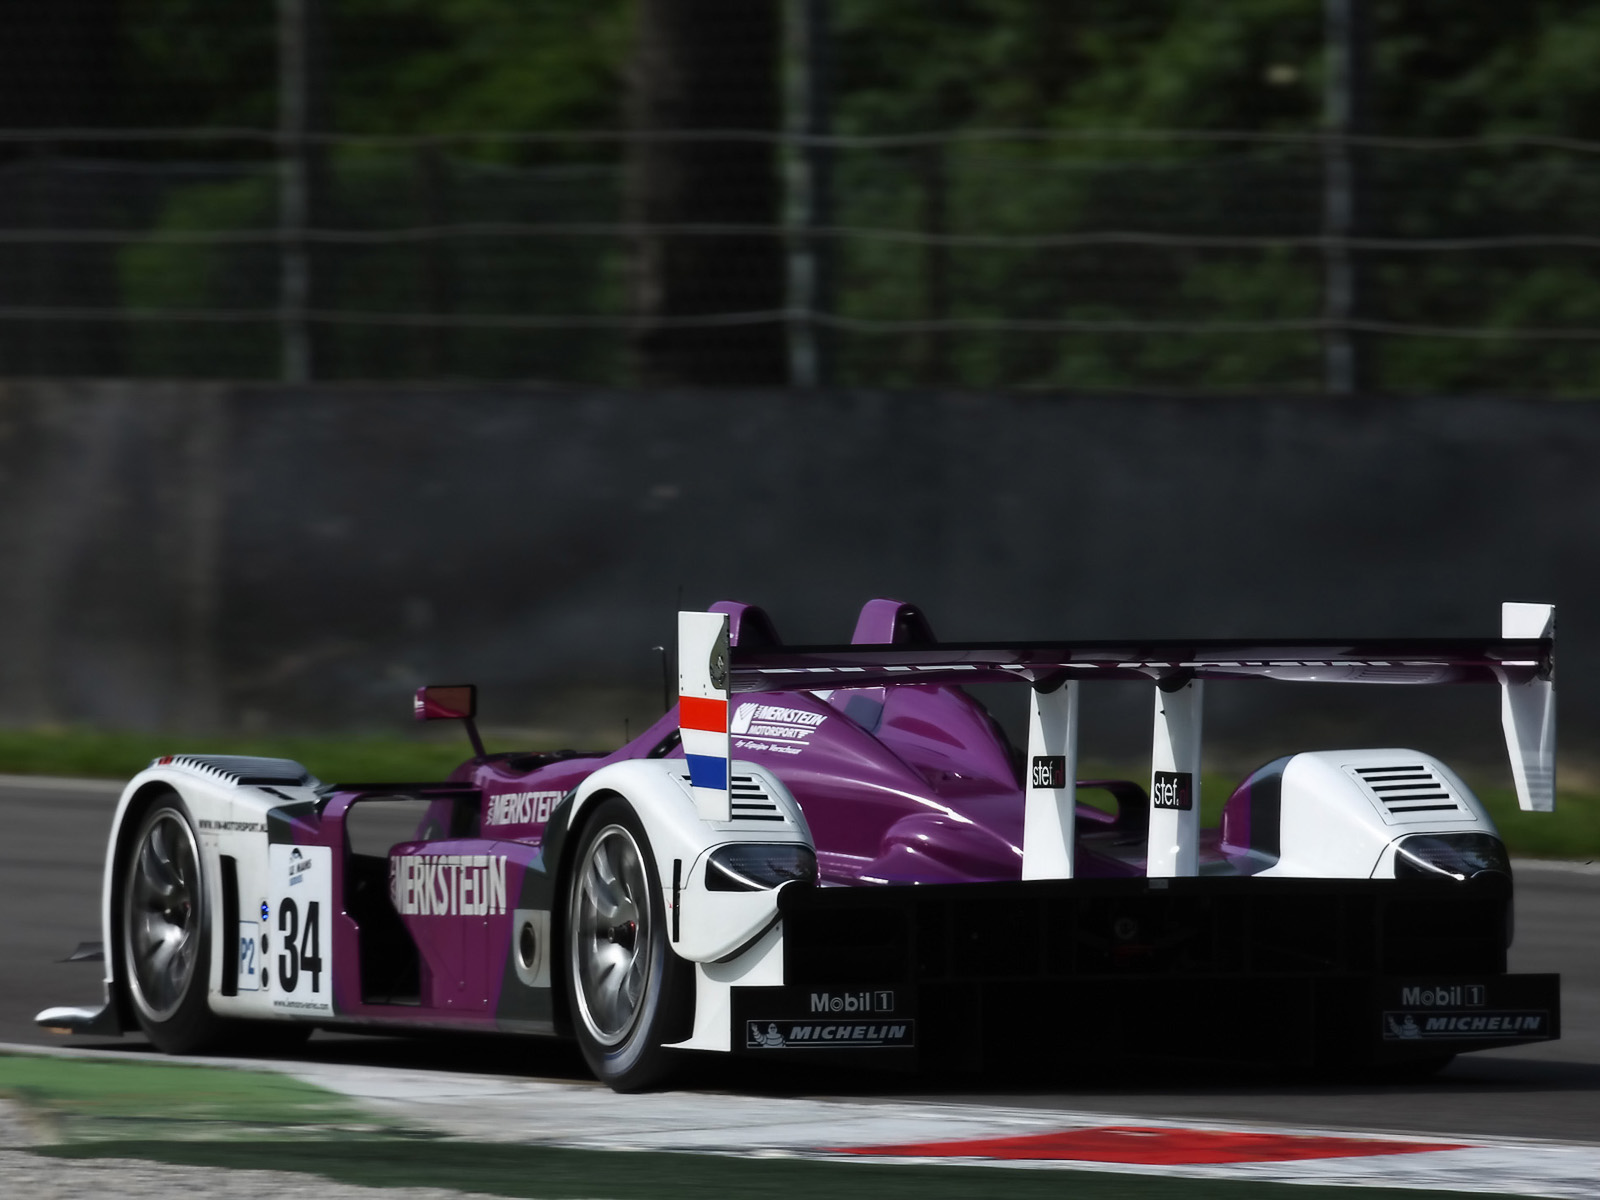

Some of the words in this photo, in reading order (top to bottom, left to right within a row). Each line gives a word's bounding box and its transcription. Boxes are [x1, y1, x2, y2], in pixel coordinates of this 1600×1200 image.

[747, 725, 798, 738] MOTORSPORT
[735, 740, 745, 748] by
[279, 897, 322, 993] 34
[240, 937, 255, 975] P2
[810, 992, 870, 1012] Mobil
[880, 993, 887, 1009] 1
[1402, 986, 1461, 1005] Mobil
[1472, 987, 1479, 1004] 1
[1425, 1017, 1541, 1030] MICHELIN
[789, 1025, 907, 1040] MICHELIN
